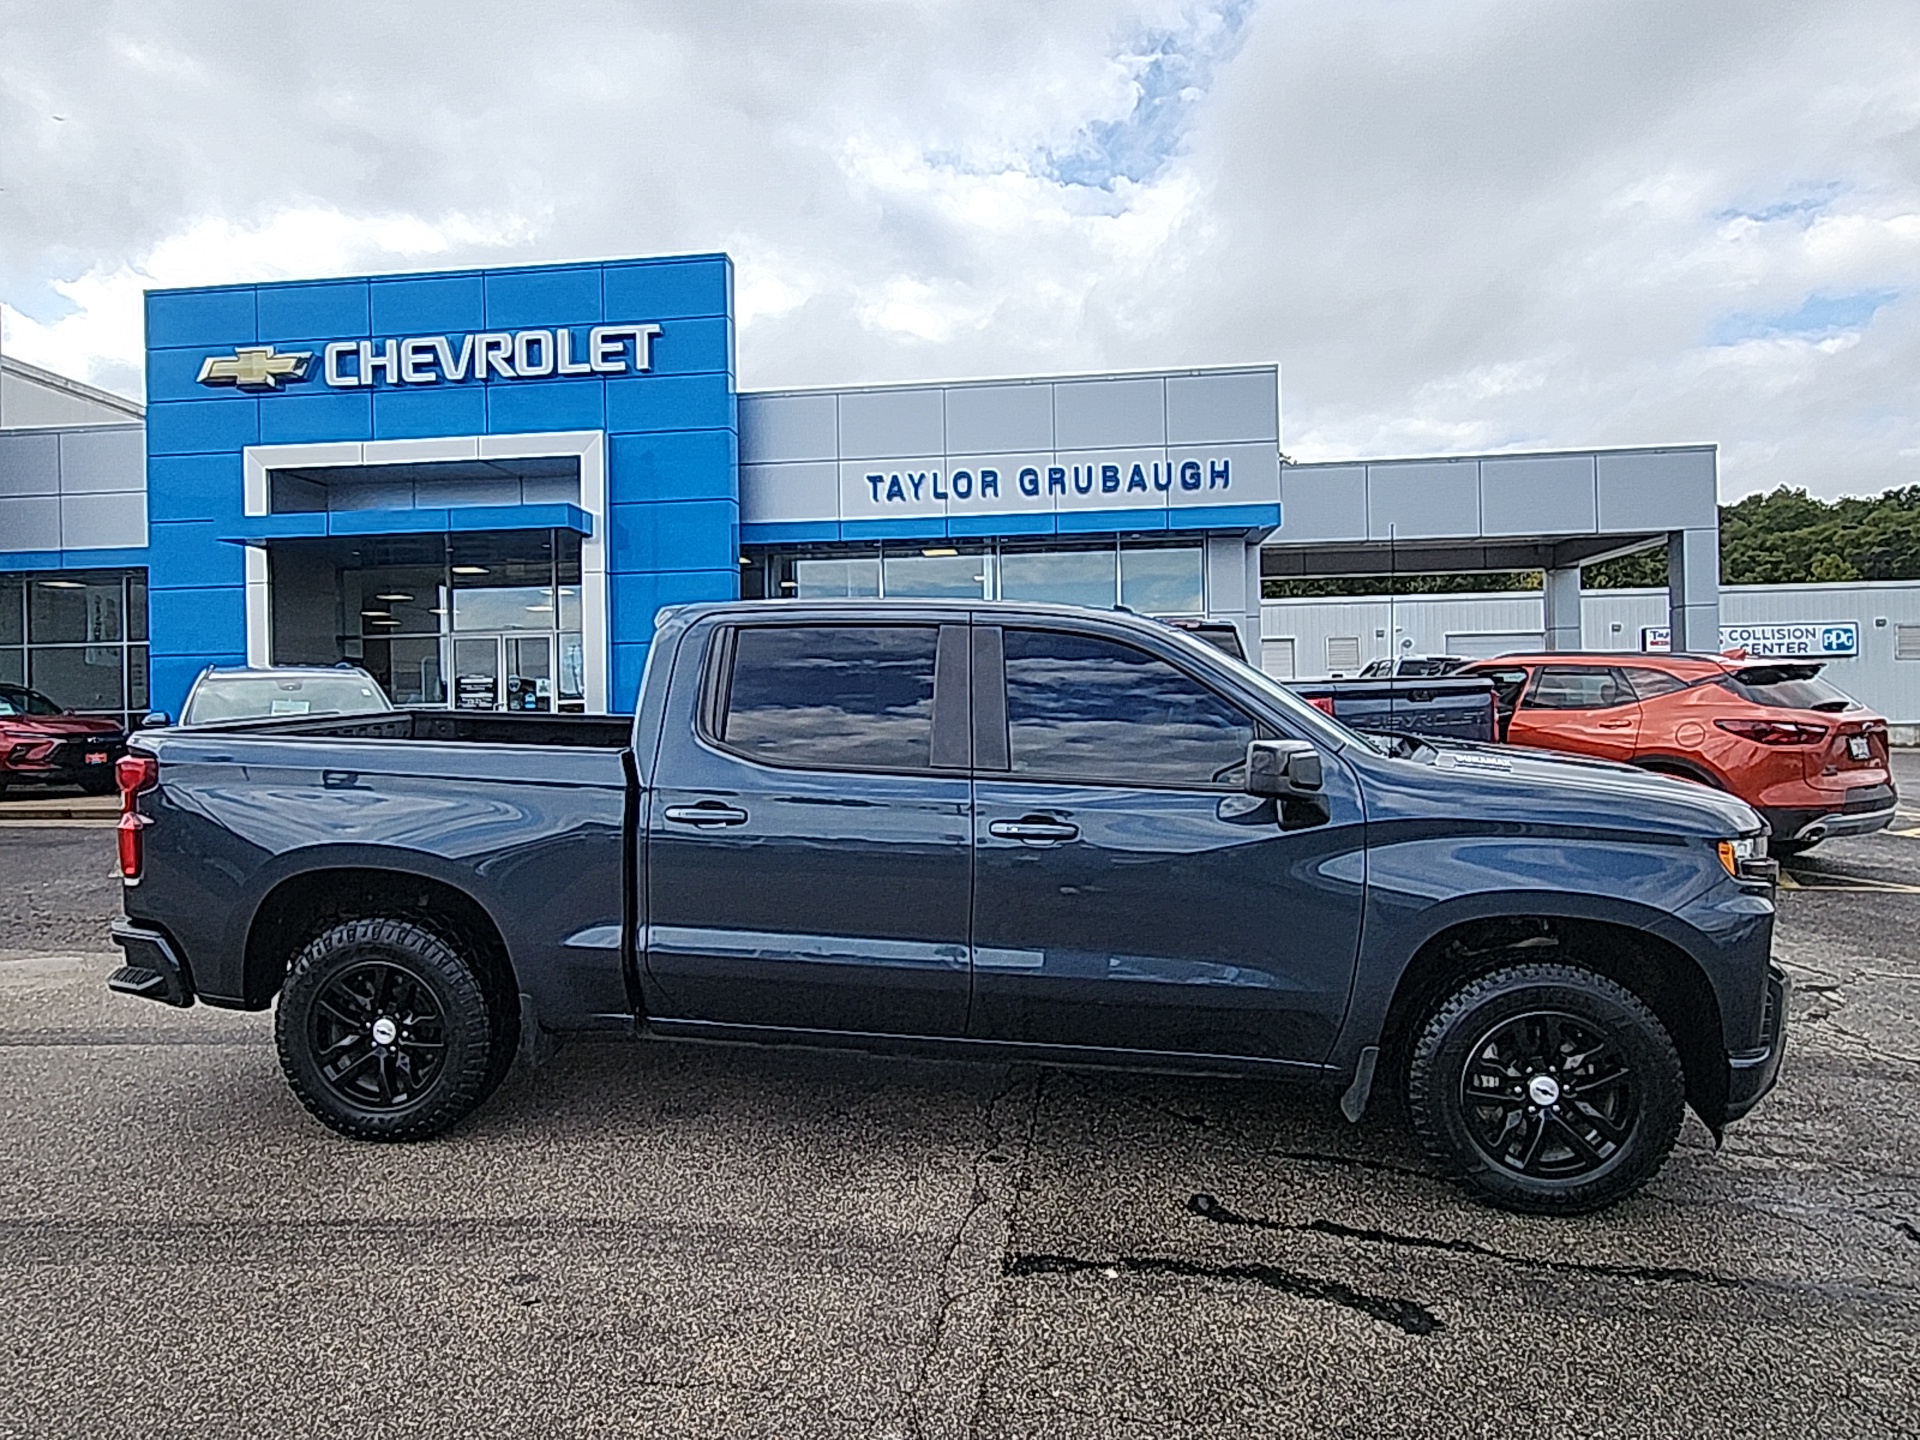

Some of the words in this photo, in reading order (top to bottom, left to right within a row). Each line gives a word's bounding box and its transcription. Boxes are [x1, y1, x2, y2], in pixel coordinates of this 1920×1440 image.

[324, 323, 662, 386] CHEVROLET
[866, 469, 999, 502] TAYLOR
[1019, 460, 1231, 496] GRUBAUGH
[1728, 628, 1817, 642] COLLISION
[1823, 629, 1854, 650] PPG
